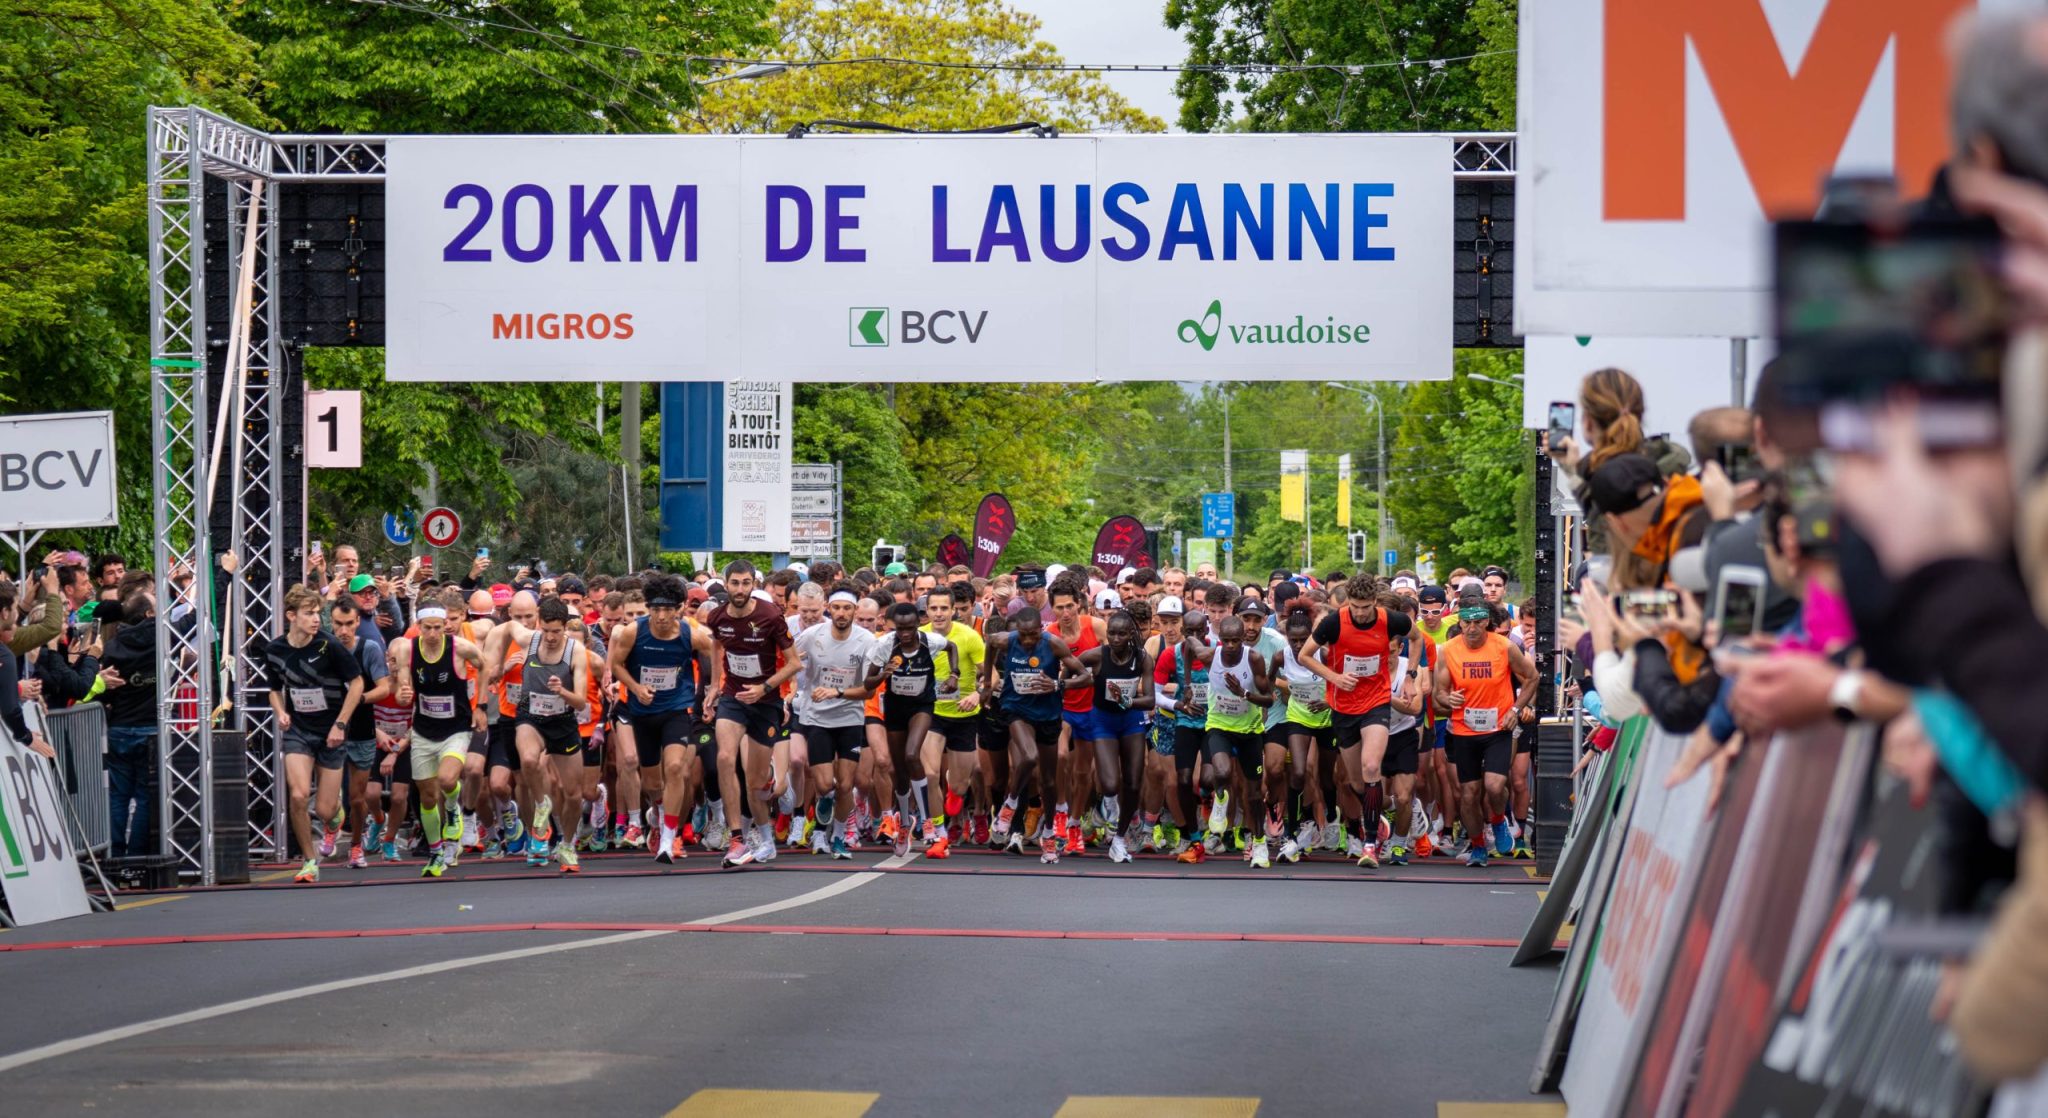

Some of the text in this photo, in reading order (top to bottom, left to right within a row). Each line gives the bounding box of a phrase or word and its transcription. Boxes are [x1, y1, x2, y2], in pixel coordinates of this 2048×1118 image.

[443, 182, 1395, 263] 20KM DE LAUSANNE
[492, 312, 634, 340] MIGROS
[901, 309, 988, 344] BCV
[1228, 315, 1371, 345] vaudoise
[738, 393, 773, 411] SEHEN
[317, 406, 338, 452] 1
[728, 432, 781, 449] BIENTÔT
[1, 449, 103, 492] BCV
[728, 461, 781, 471] SEE YOU
[801, 470, 810, 479] de
[812, 469, 828, 481] Vidy
[728, 472, 781, 483] AGAIN
[977, 536, 1000, 555] 1:30h
[1097, 552, 1125, 565] 1:30h
[1462, 668, 1492, 679] I RUN
